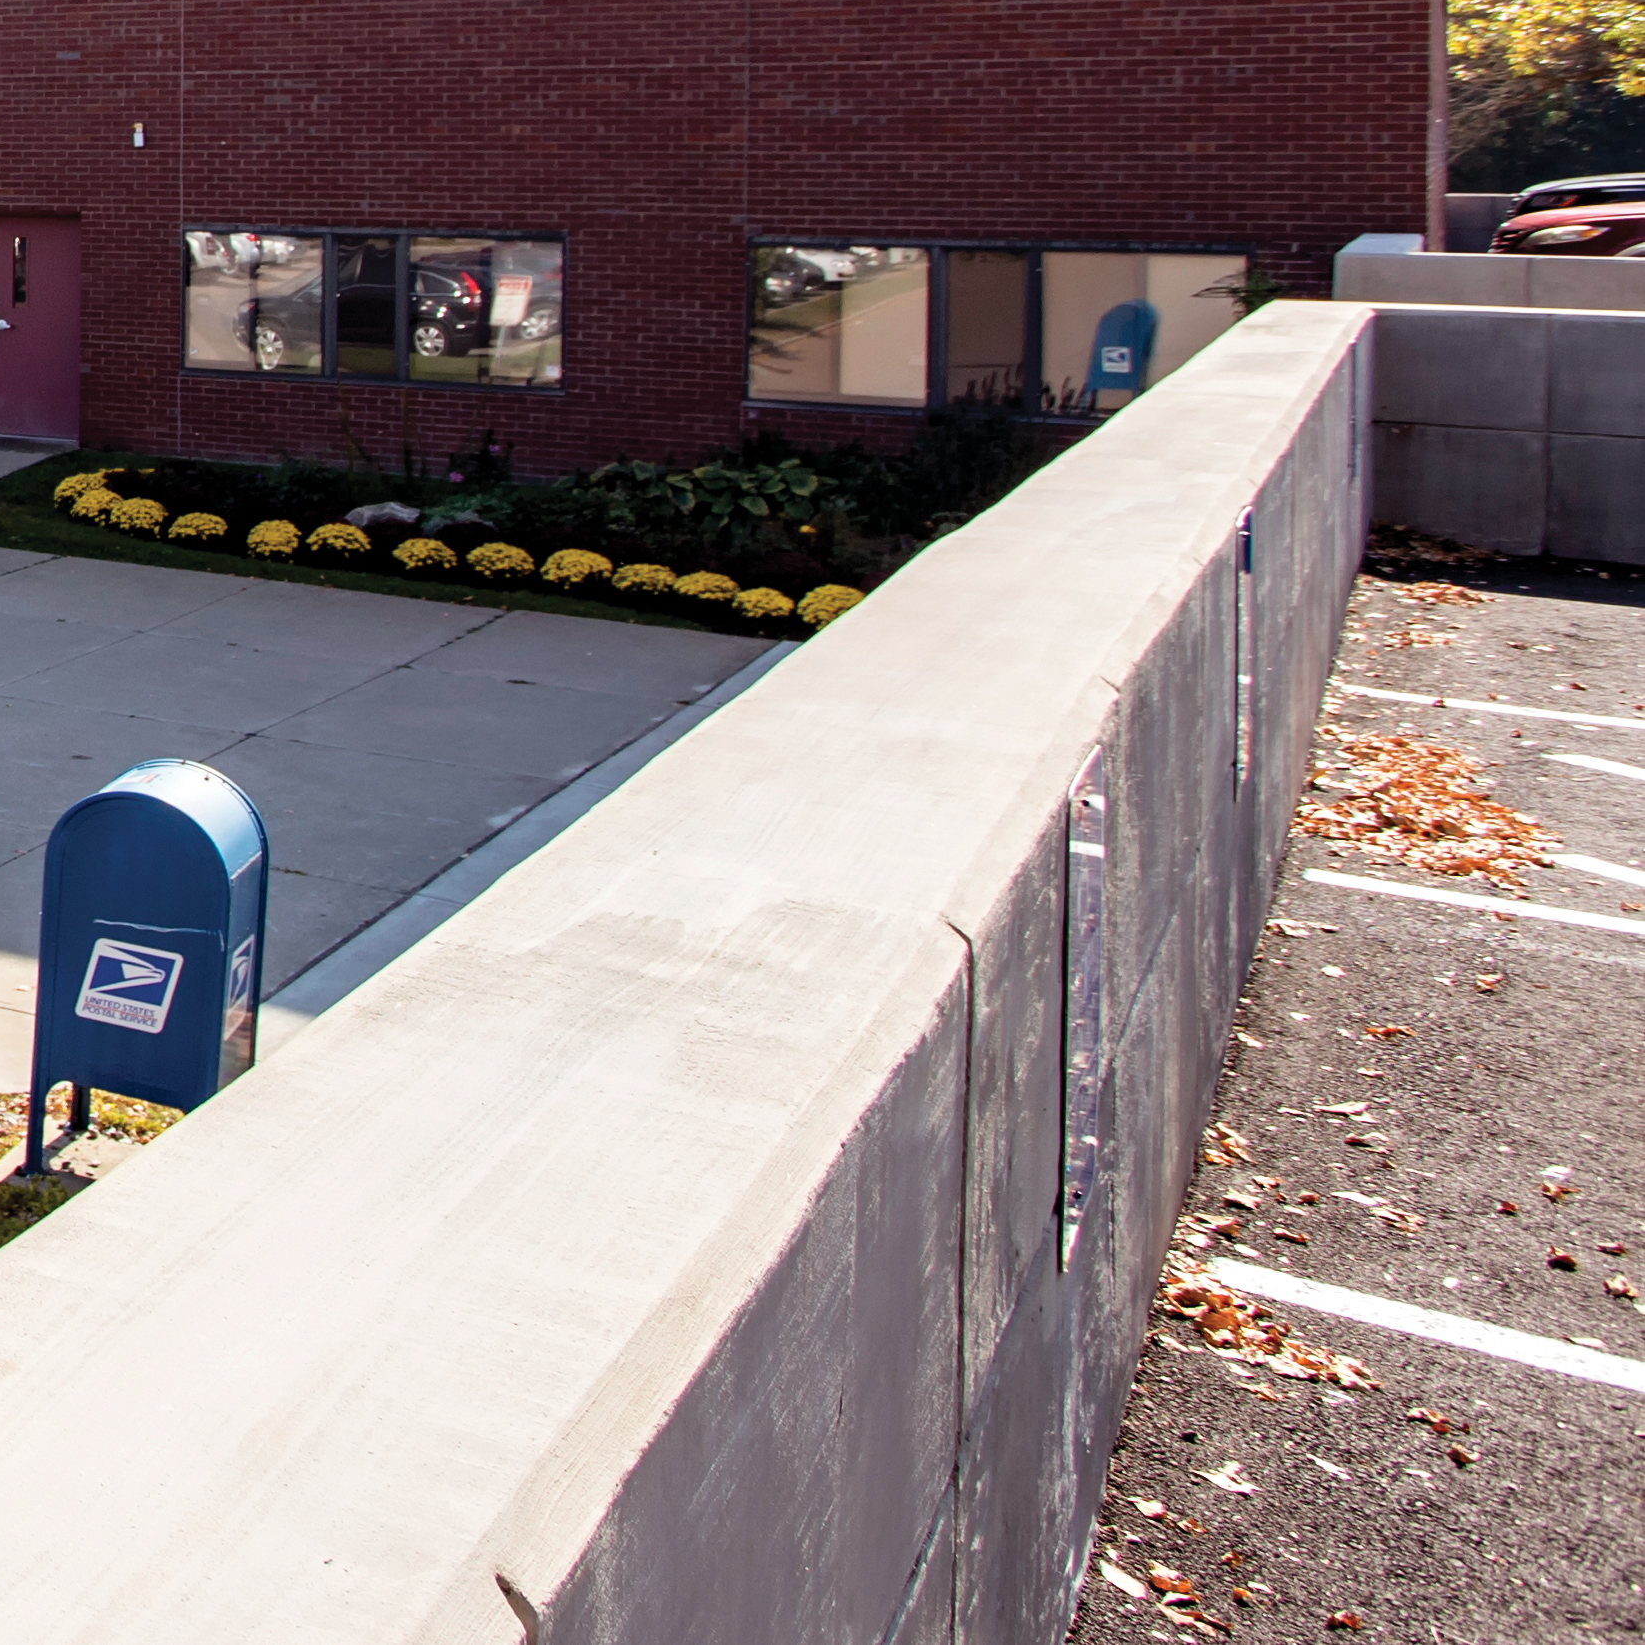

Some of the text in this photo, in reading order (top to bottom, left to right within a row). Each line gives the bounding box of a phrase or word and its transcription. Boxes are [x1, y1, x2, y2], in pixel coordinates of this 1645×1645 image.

[83, 1004, 156, 1027] POSTAL SERVICE
[85, 996, 155, 1017] UNITED STATES
